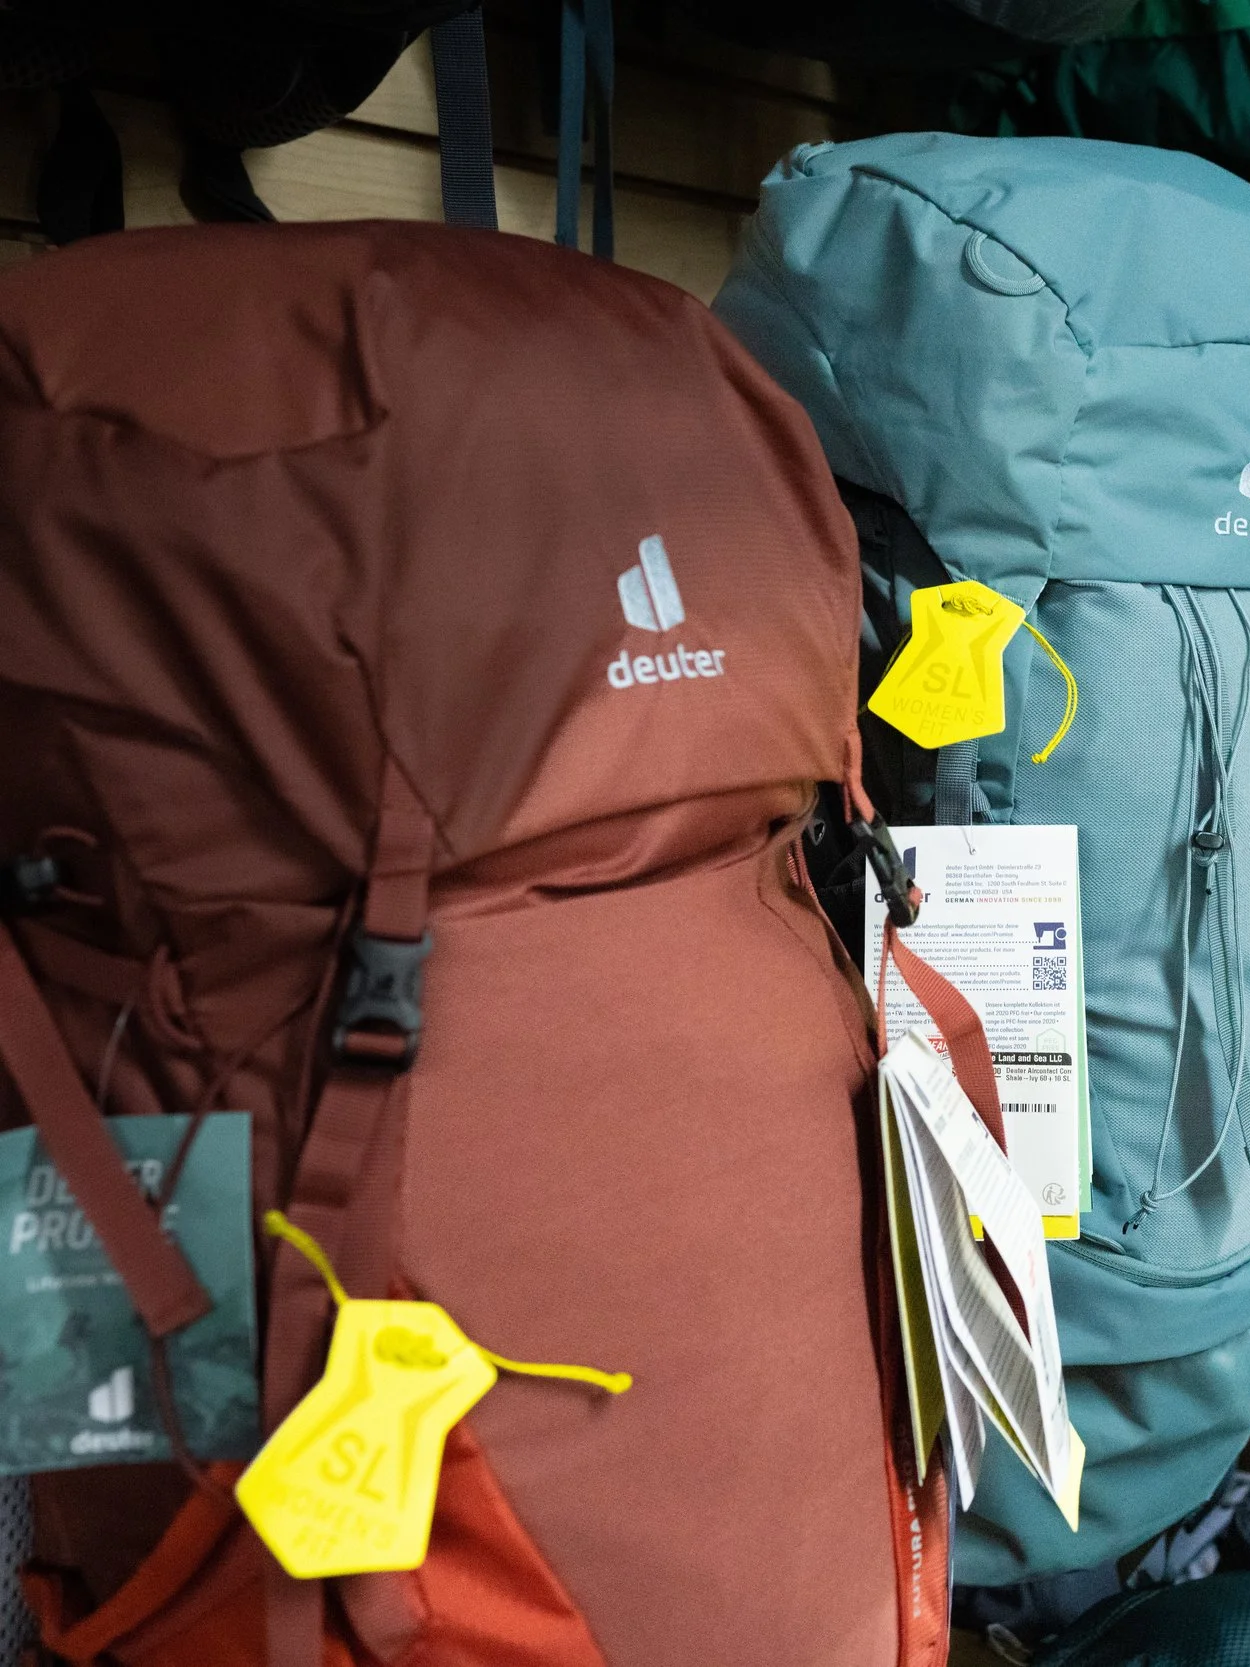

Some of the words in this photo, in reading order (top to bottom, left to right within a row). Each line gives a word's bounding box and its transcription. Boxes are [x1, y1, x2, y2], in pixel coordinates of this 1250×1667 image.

[606, 643, 726, 690] deuter
[922, 662, 972, 700] SL
[893, 694, 986, 726] WOMEN'S
[918, 719, 950, 737] FIT
[998, 1054, 1016, 1063] Land
[1017, 1054, 1032, 1063] and
[1033, 1054, 1048, 1063] Sea
[1049, 1055, 1063, 1063] LLC
[318, 1431, 388, 1502] SL
